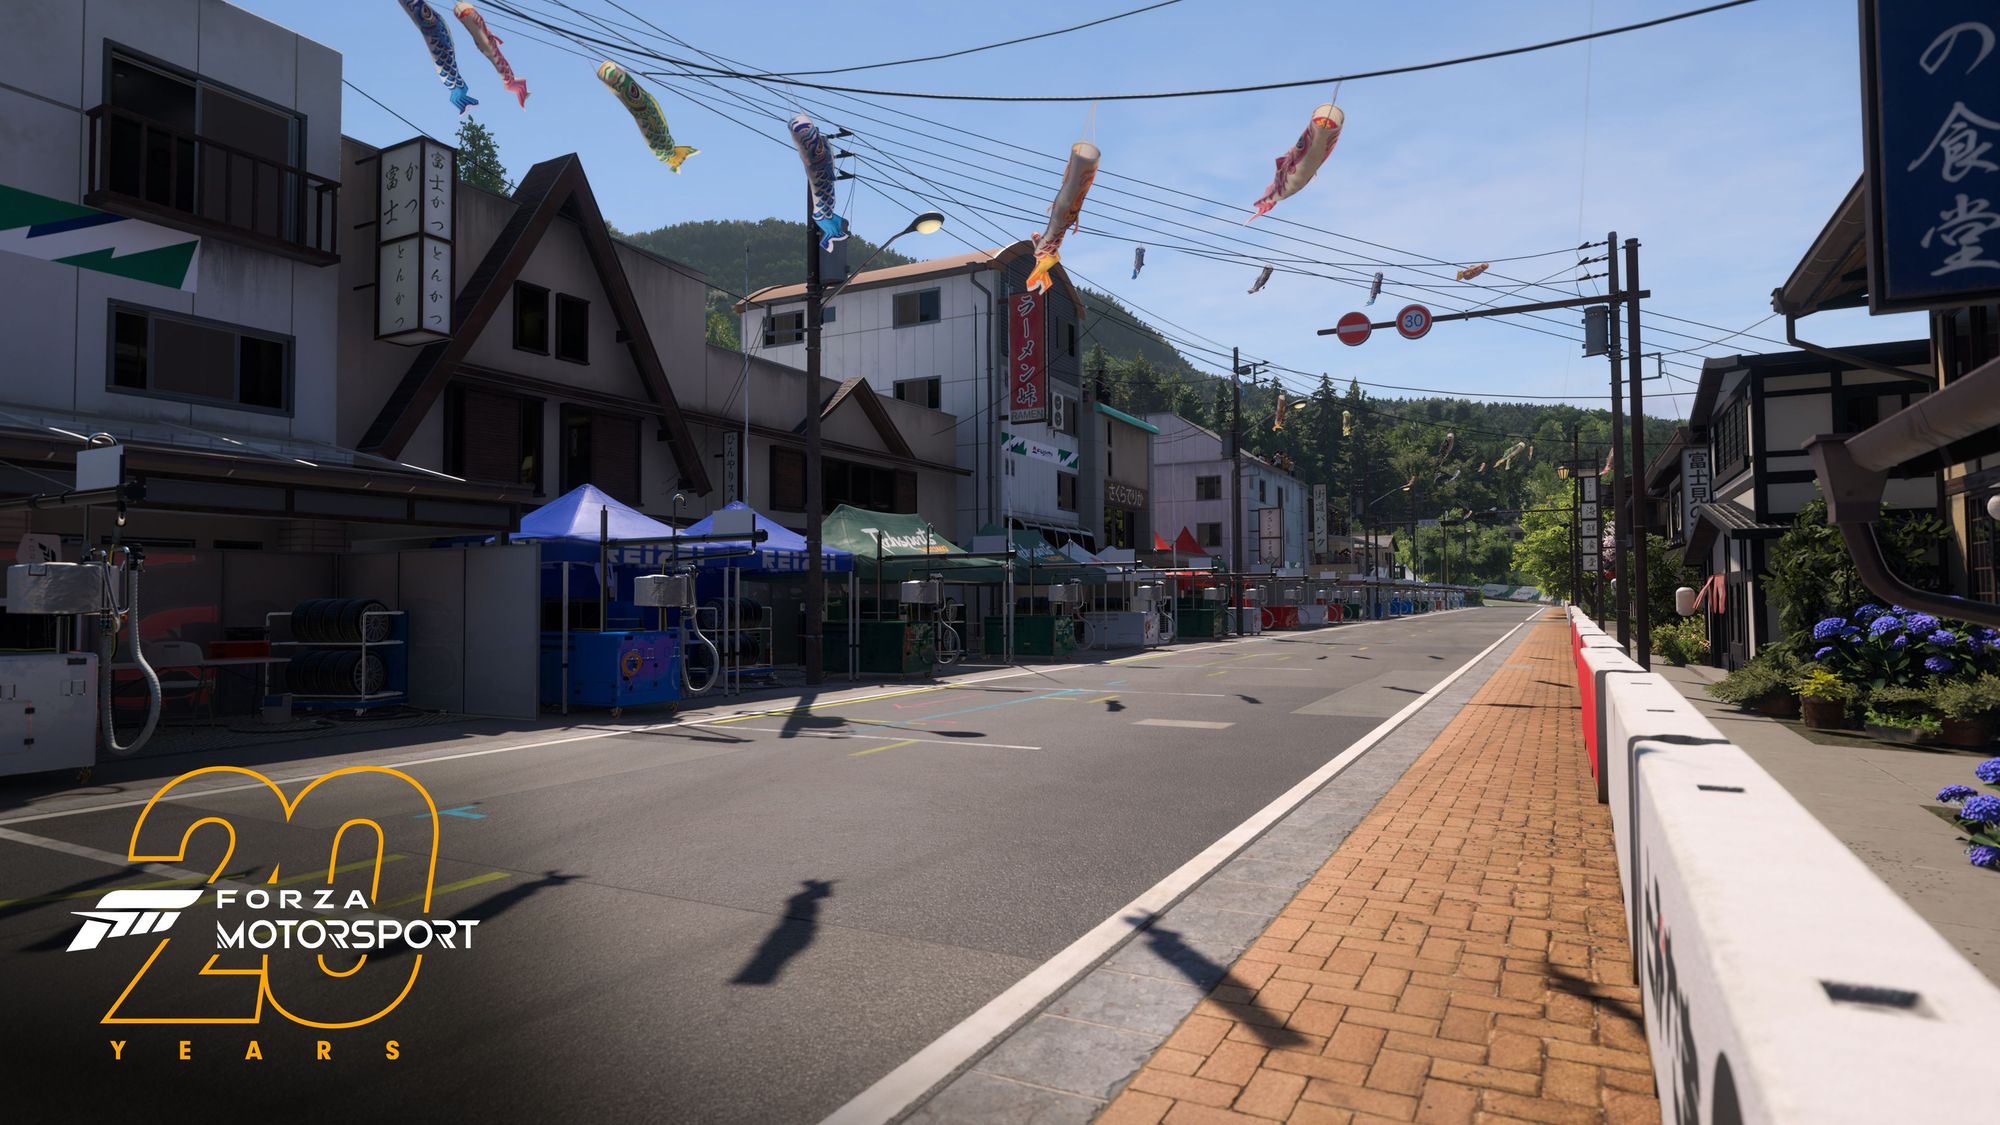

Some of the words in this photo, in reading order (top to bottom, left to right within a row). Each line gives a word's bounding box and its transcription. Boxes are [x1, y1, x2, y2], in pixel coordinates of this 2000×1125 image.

[1907, 21, 2000, 277] の食堂
[384, 164, 400, 225] 富士
[429, 151, 446, 232] 富士かつ
[394, 246, 406, 326] とんかつ
[429, 245, 443, 325] とんかつ
[1404, 313, 1424, 329] 30
[1017, 294, 1038, 406] ラーメン峠
[1011, 408, 1044, 421] RAMEN
